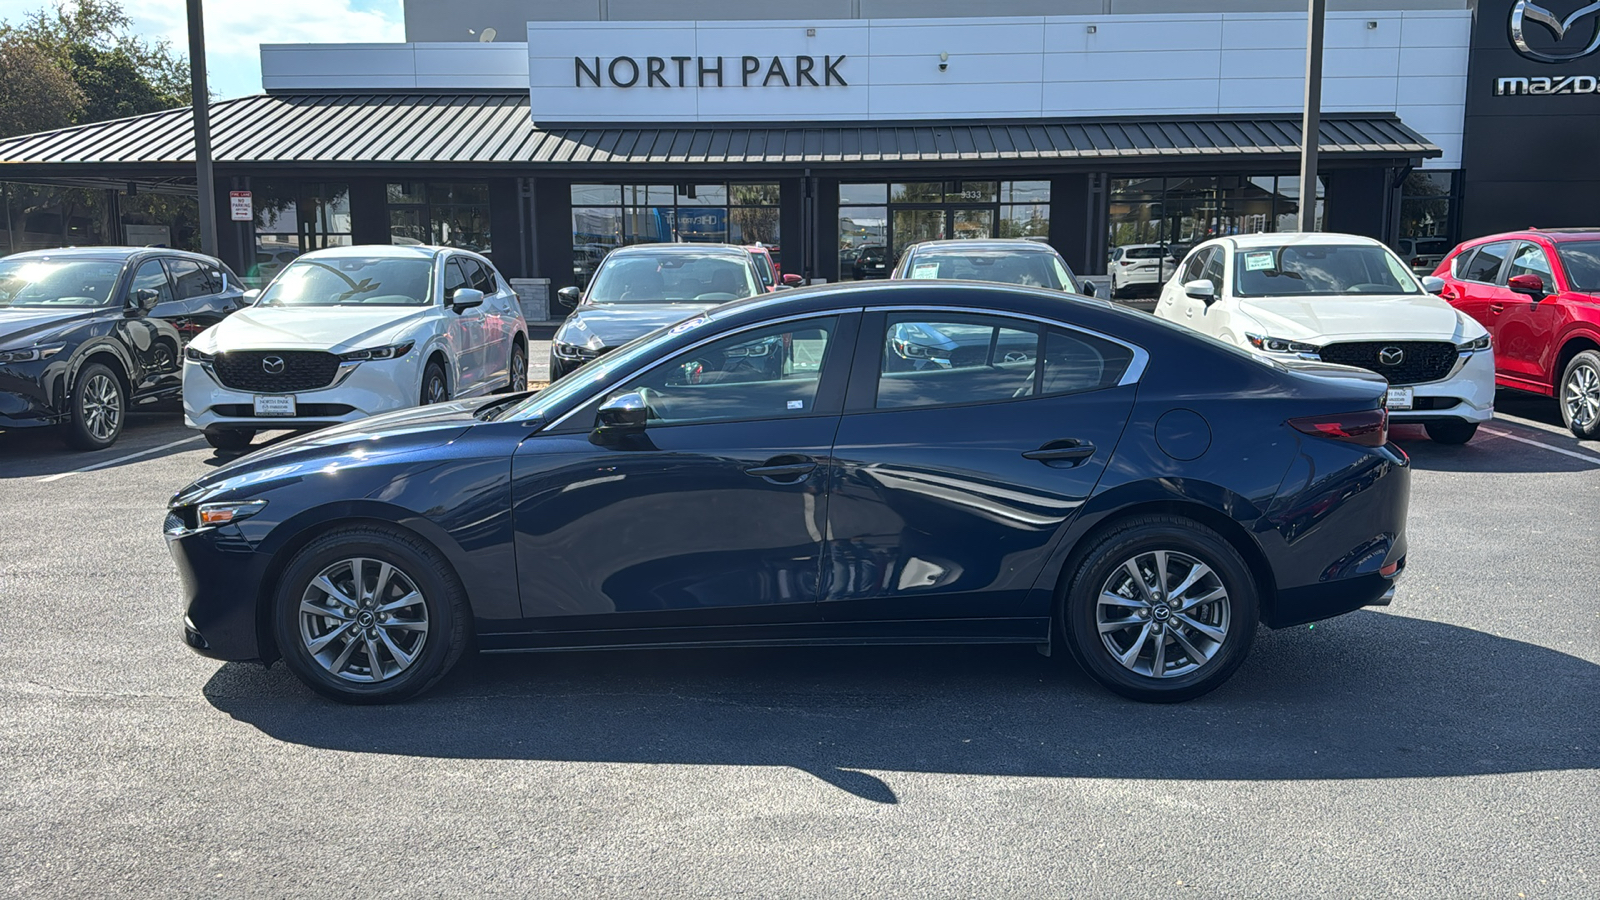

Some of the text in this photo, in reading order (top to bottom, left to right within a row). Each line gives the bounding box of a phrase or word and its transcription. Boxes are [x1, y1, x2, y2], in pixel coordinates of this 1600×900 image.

[574, 54, 849, 89] NORTH PARK
[1497, 75, 1600, 96] mazD
